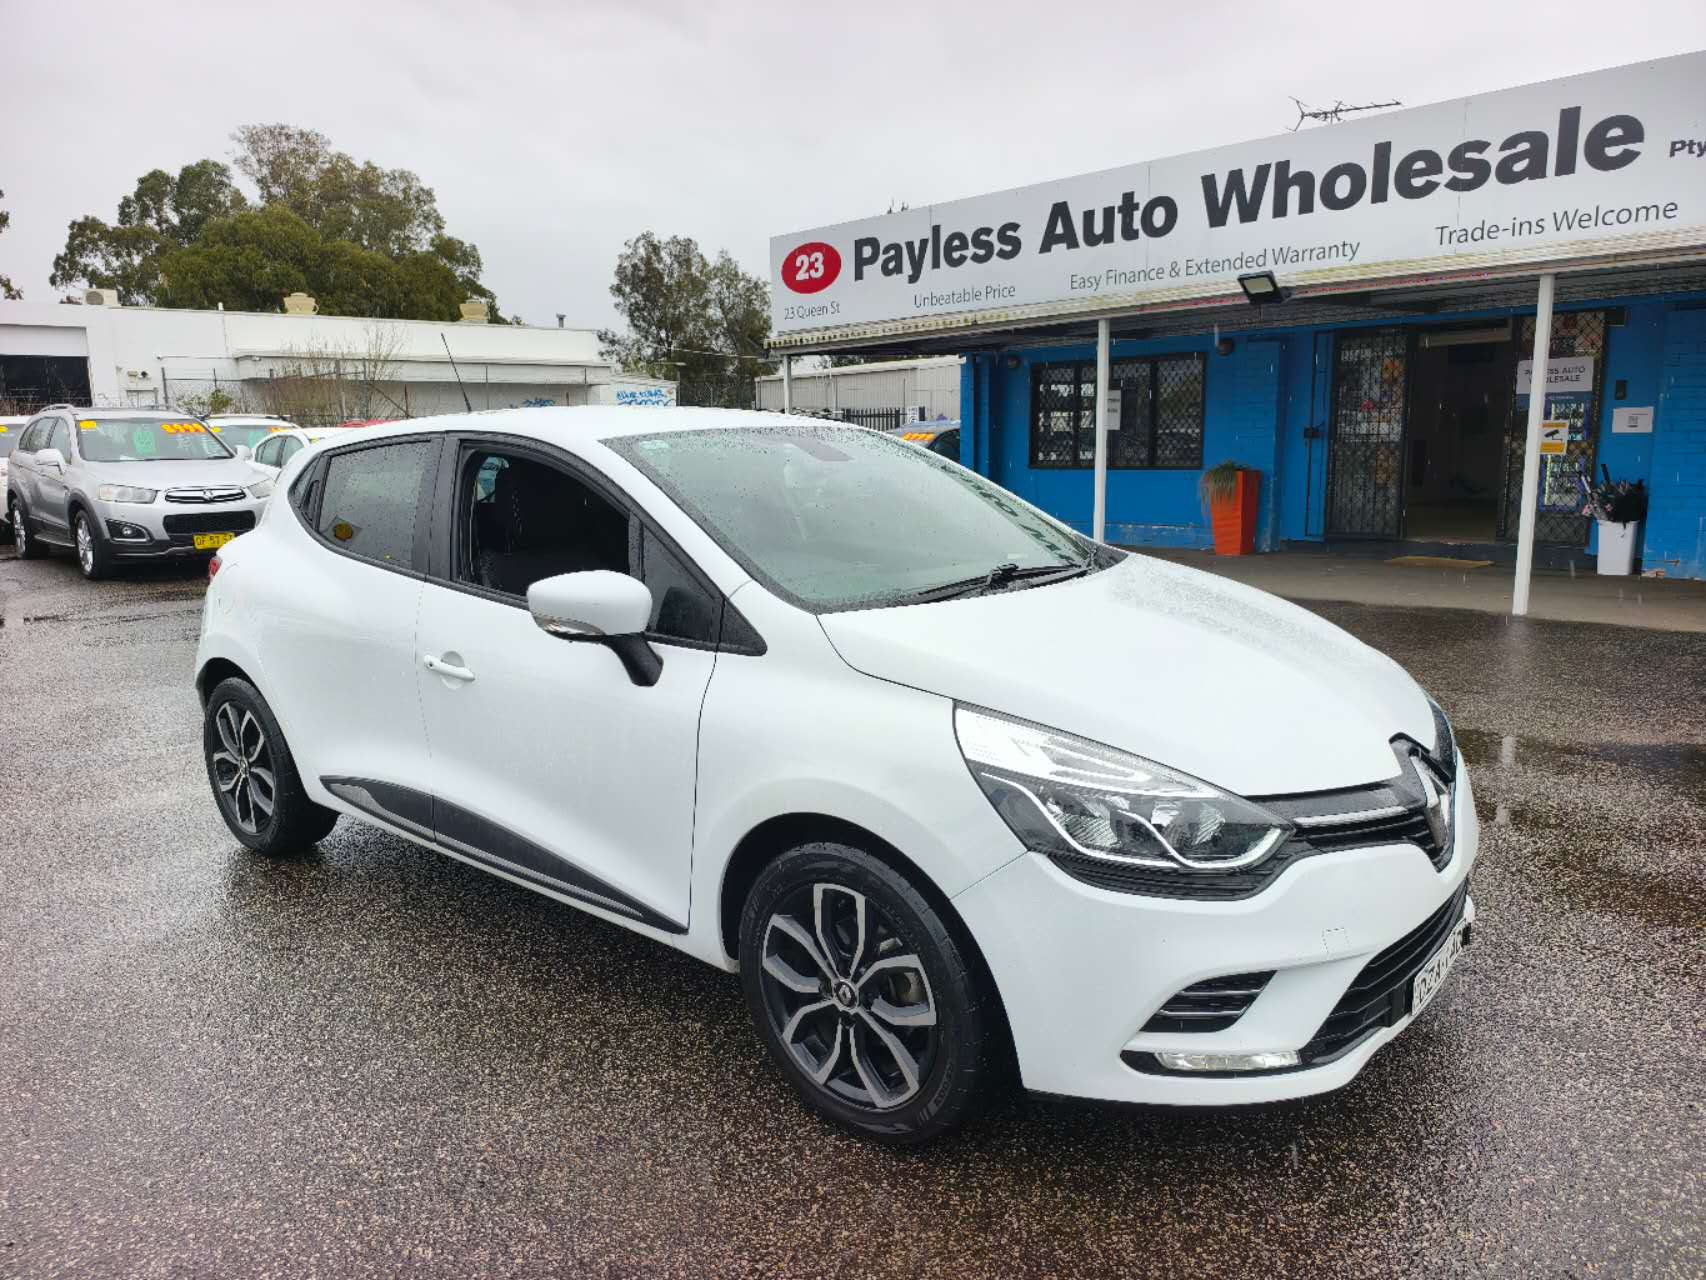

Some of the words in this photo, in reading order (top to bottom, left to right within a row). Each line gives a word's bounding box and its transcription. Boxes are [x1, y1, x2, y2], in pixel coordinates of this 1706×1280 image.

[855, 222, 1022, 285] Payless
[1039, 190, 1178, 254] Auto
[1202, 106, 1646, 228] Wholesale
[1669, 139, 1706, 158] Pty
[1437, 217, 1545, 246] Trade-ins
[1552, 201, 1679, 232] Welcome
[795, 251, 825, 281] 23
[1071, 274, 1102, 292] Easy
[1106, 266, 1165, 286] Finance
[1169, 260, 1181, 279] &
[1185, 252, 1267, 277] Extended
[1271, 241, 1362, 267] Warranty
[784, 306, 796, 320] 23
[796, 304, 829, 319] Queen
[830, 301, 840, 315] St
[914, 288, 982, 309] Unbeatable
[985, 284, 1016, 301] Price
